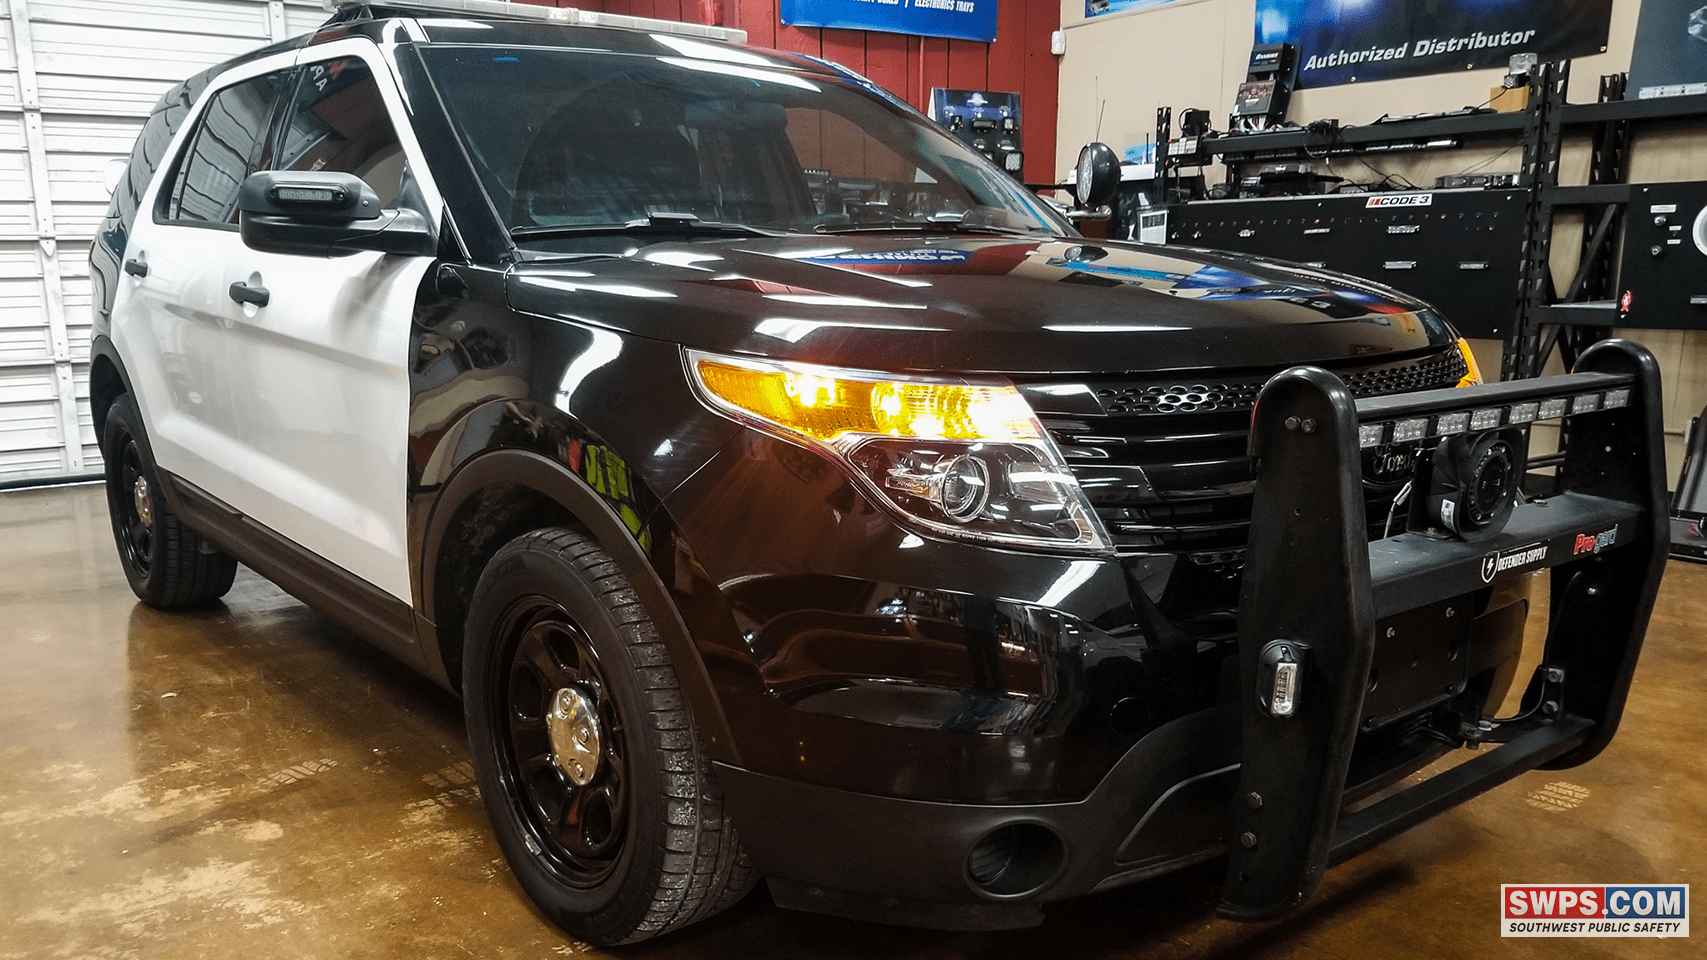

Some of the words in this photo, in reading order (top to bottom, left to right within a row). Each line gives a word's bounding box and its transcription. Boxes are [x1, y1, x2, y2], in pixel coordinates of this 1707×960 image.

[915, 0, 955, 10] ELECTRONICS
[956, 0, 974, 12] TRAYS
[1303, 42, 1409, 71] Authorized
[1412, 30, 1536, 58] Distributor
[1380, 196, 1418, 205] CODE
[1419, 196, 1429, 204] 3
[1497, 551, 1527, 572] DEFENDER
[1525, 545, 1548, 564] SUPPLY
